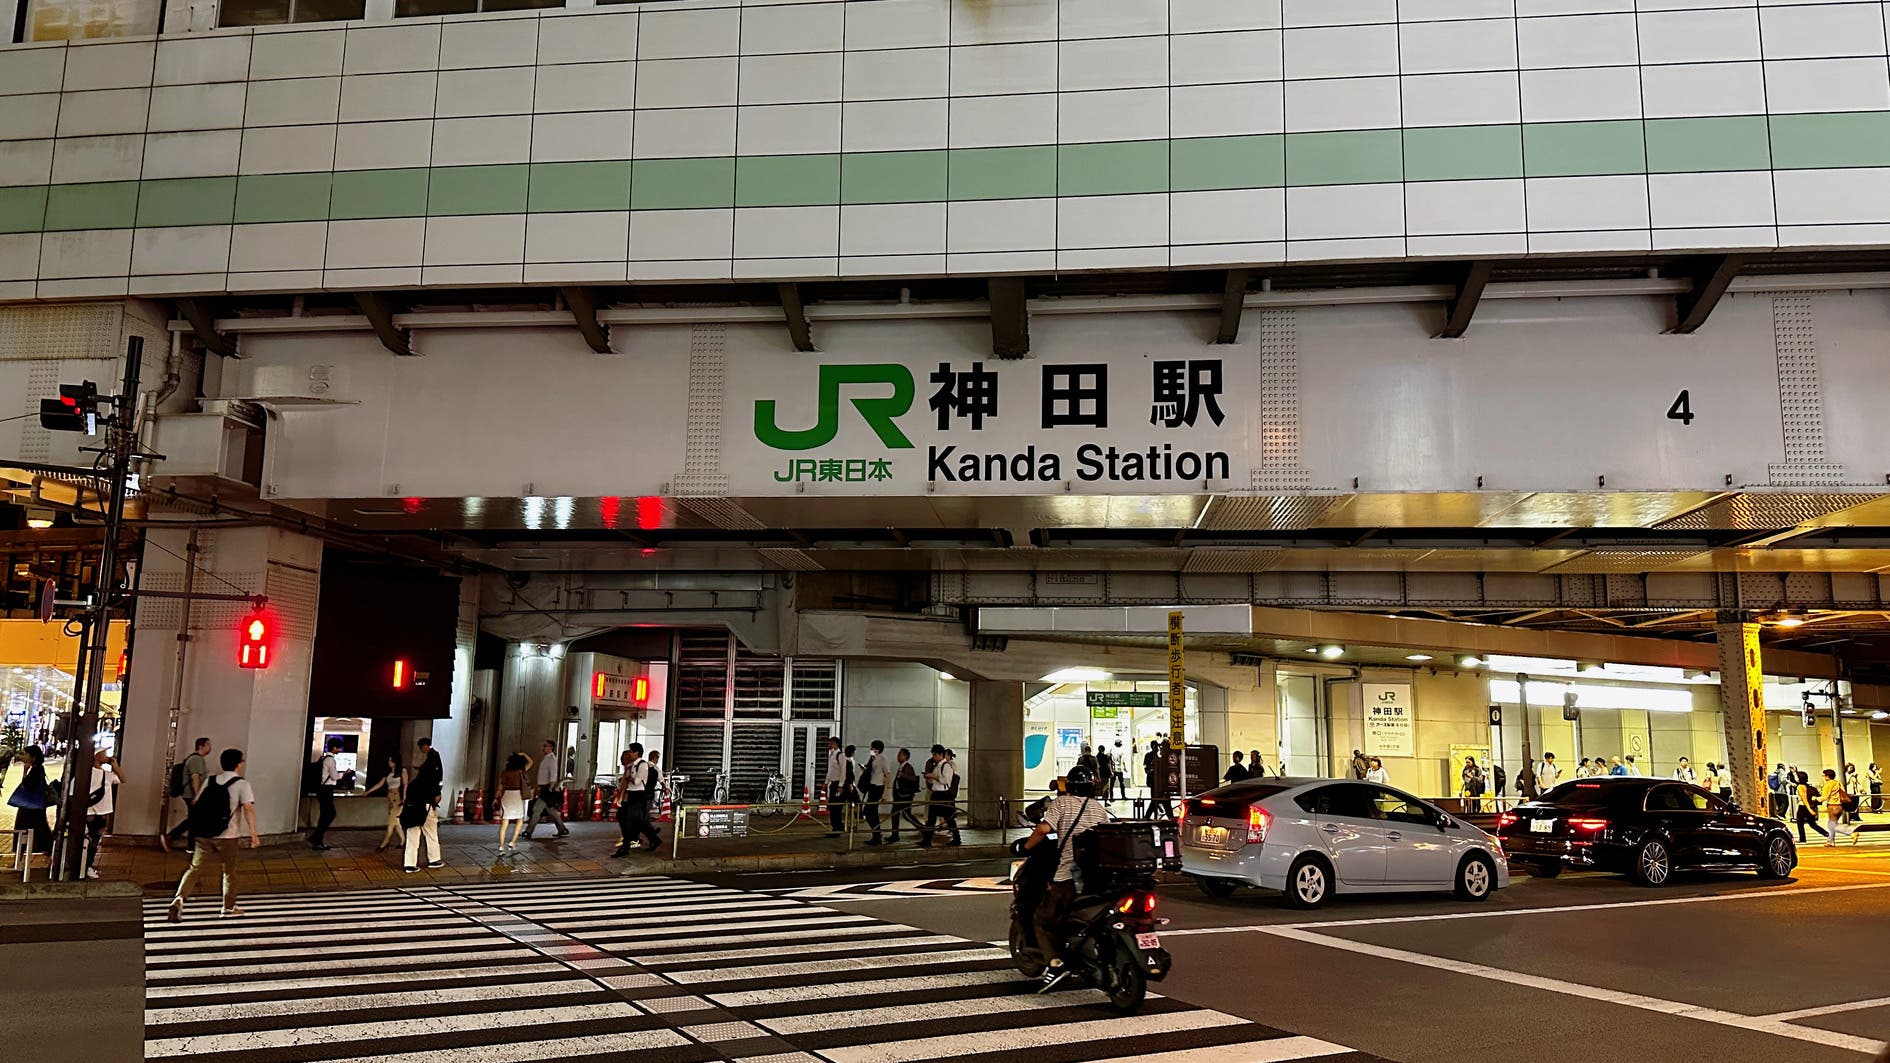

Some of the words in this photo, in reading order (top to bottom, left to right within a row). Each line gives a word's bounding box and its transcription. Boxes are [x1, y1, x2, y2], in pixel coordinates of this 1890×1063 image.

[755, 364, 915, 450] JR
[928, 360, 1225, 431] 神田駅
[1667, 390, 1694, 425] 4
[774, 459, 893, 482] JR東日本
[928, 446, 1061, 481] Kanda
[1076, 444, 1230, 482] Station
[1089, 693, 1104, 702] JR
[1170, 615, 1183, 746] 横断歩行者に注意
[1378, 692, 1396, 700] JR
